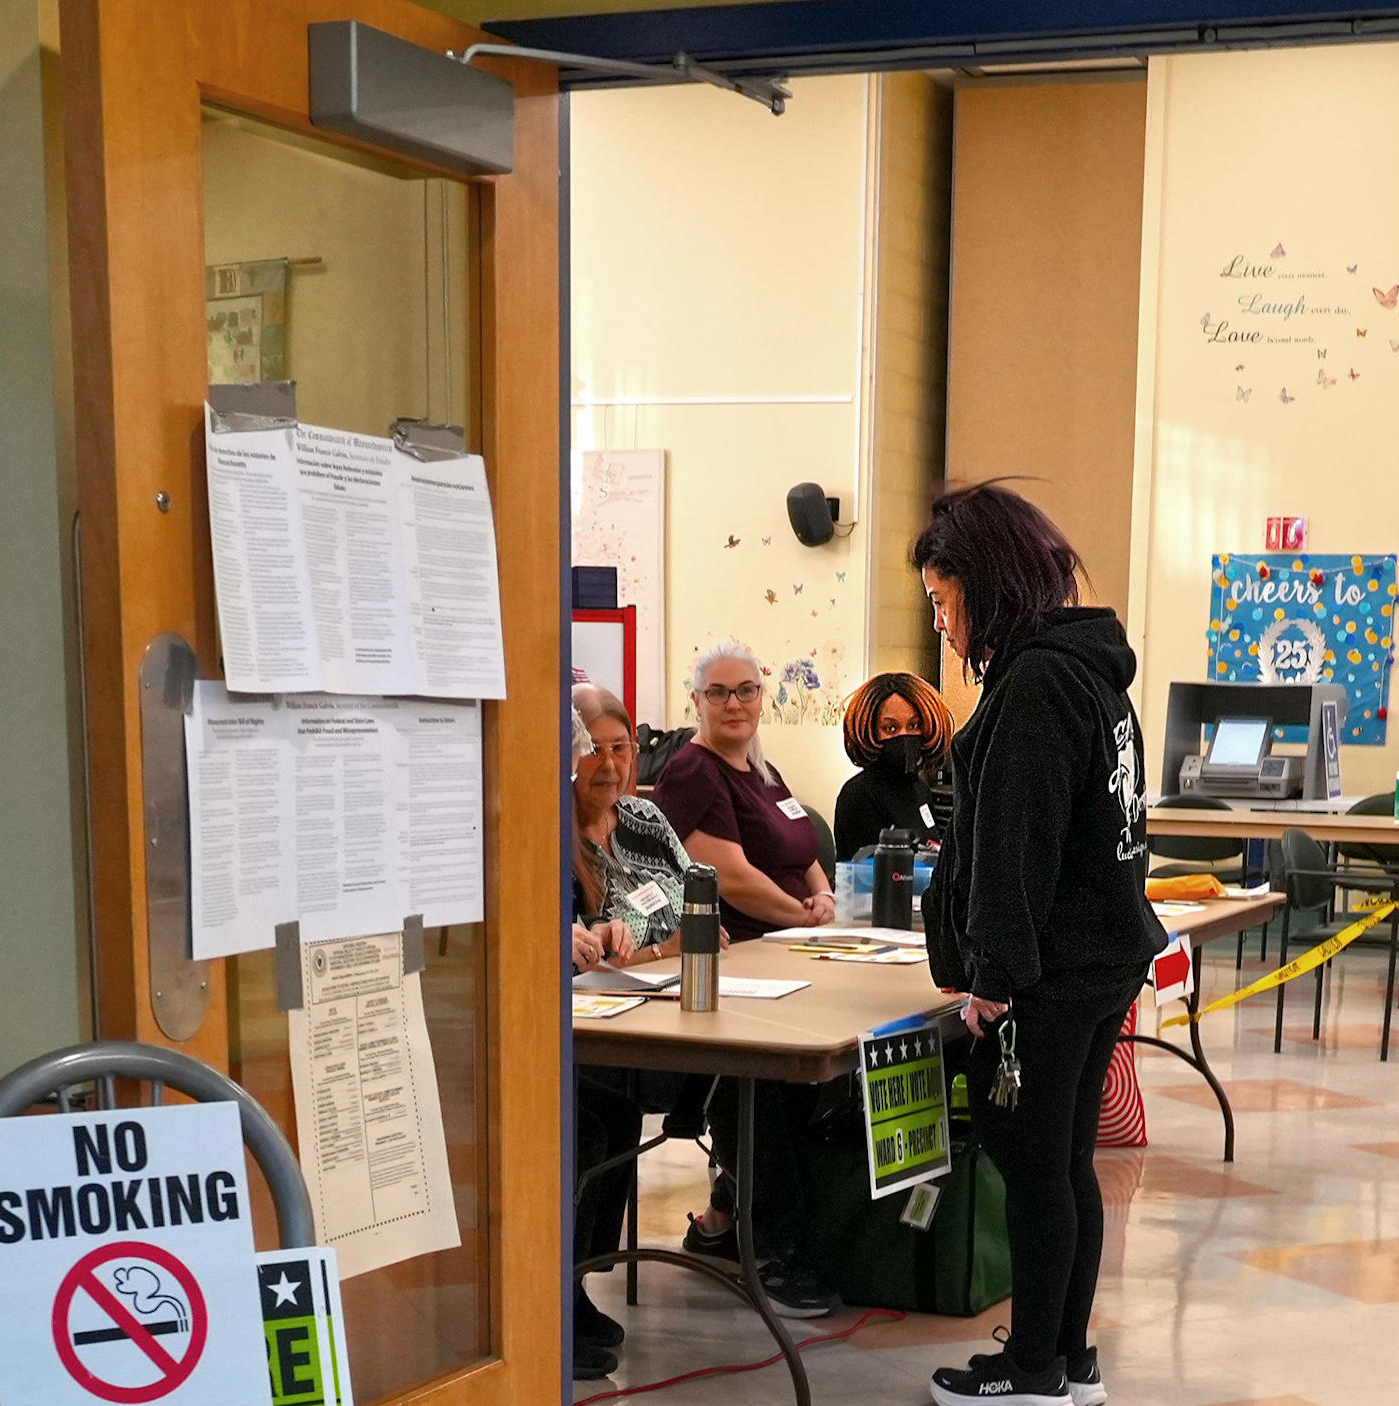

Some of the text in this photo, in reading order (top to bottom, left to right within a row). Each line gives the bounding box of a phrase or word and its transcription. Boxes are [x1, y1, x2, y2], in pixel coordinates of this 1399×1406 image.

[1220, 254, 1276, 278] Live
[1237, 293, 1306, 322] Laugh
[1203, 320, 1263, 343] Love
[1231, 572, 1366, 605] cheers to
[1276, 640, 1308, 669] 25
[869, 1078, 889, 1113] VOTE
[888, 1074, 905, 1108] HERE
[73, 1120, 148, 1176] NO
[876, 1136, 896, 1168] WARD
[897, 1132, 903, 1161] 6
[979, 1380, 1013, 1394] HOKA
